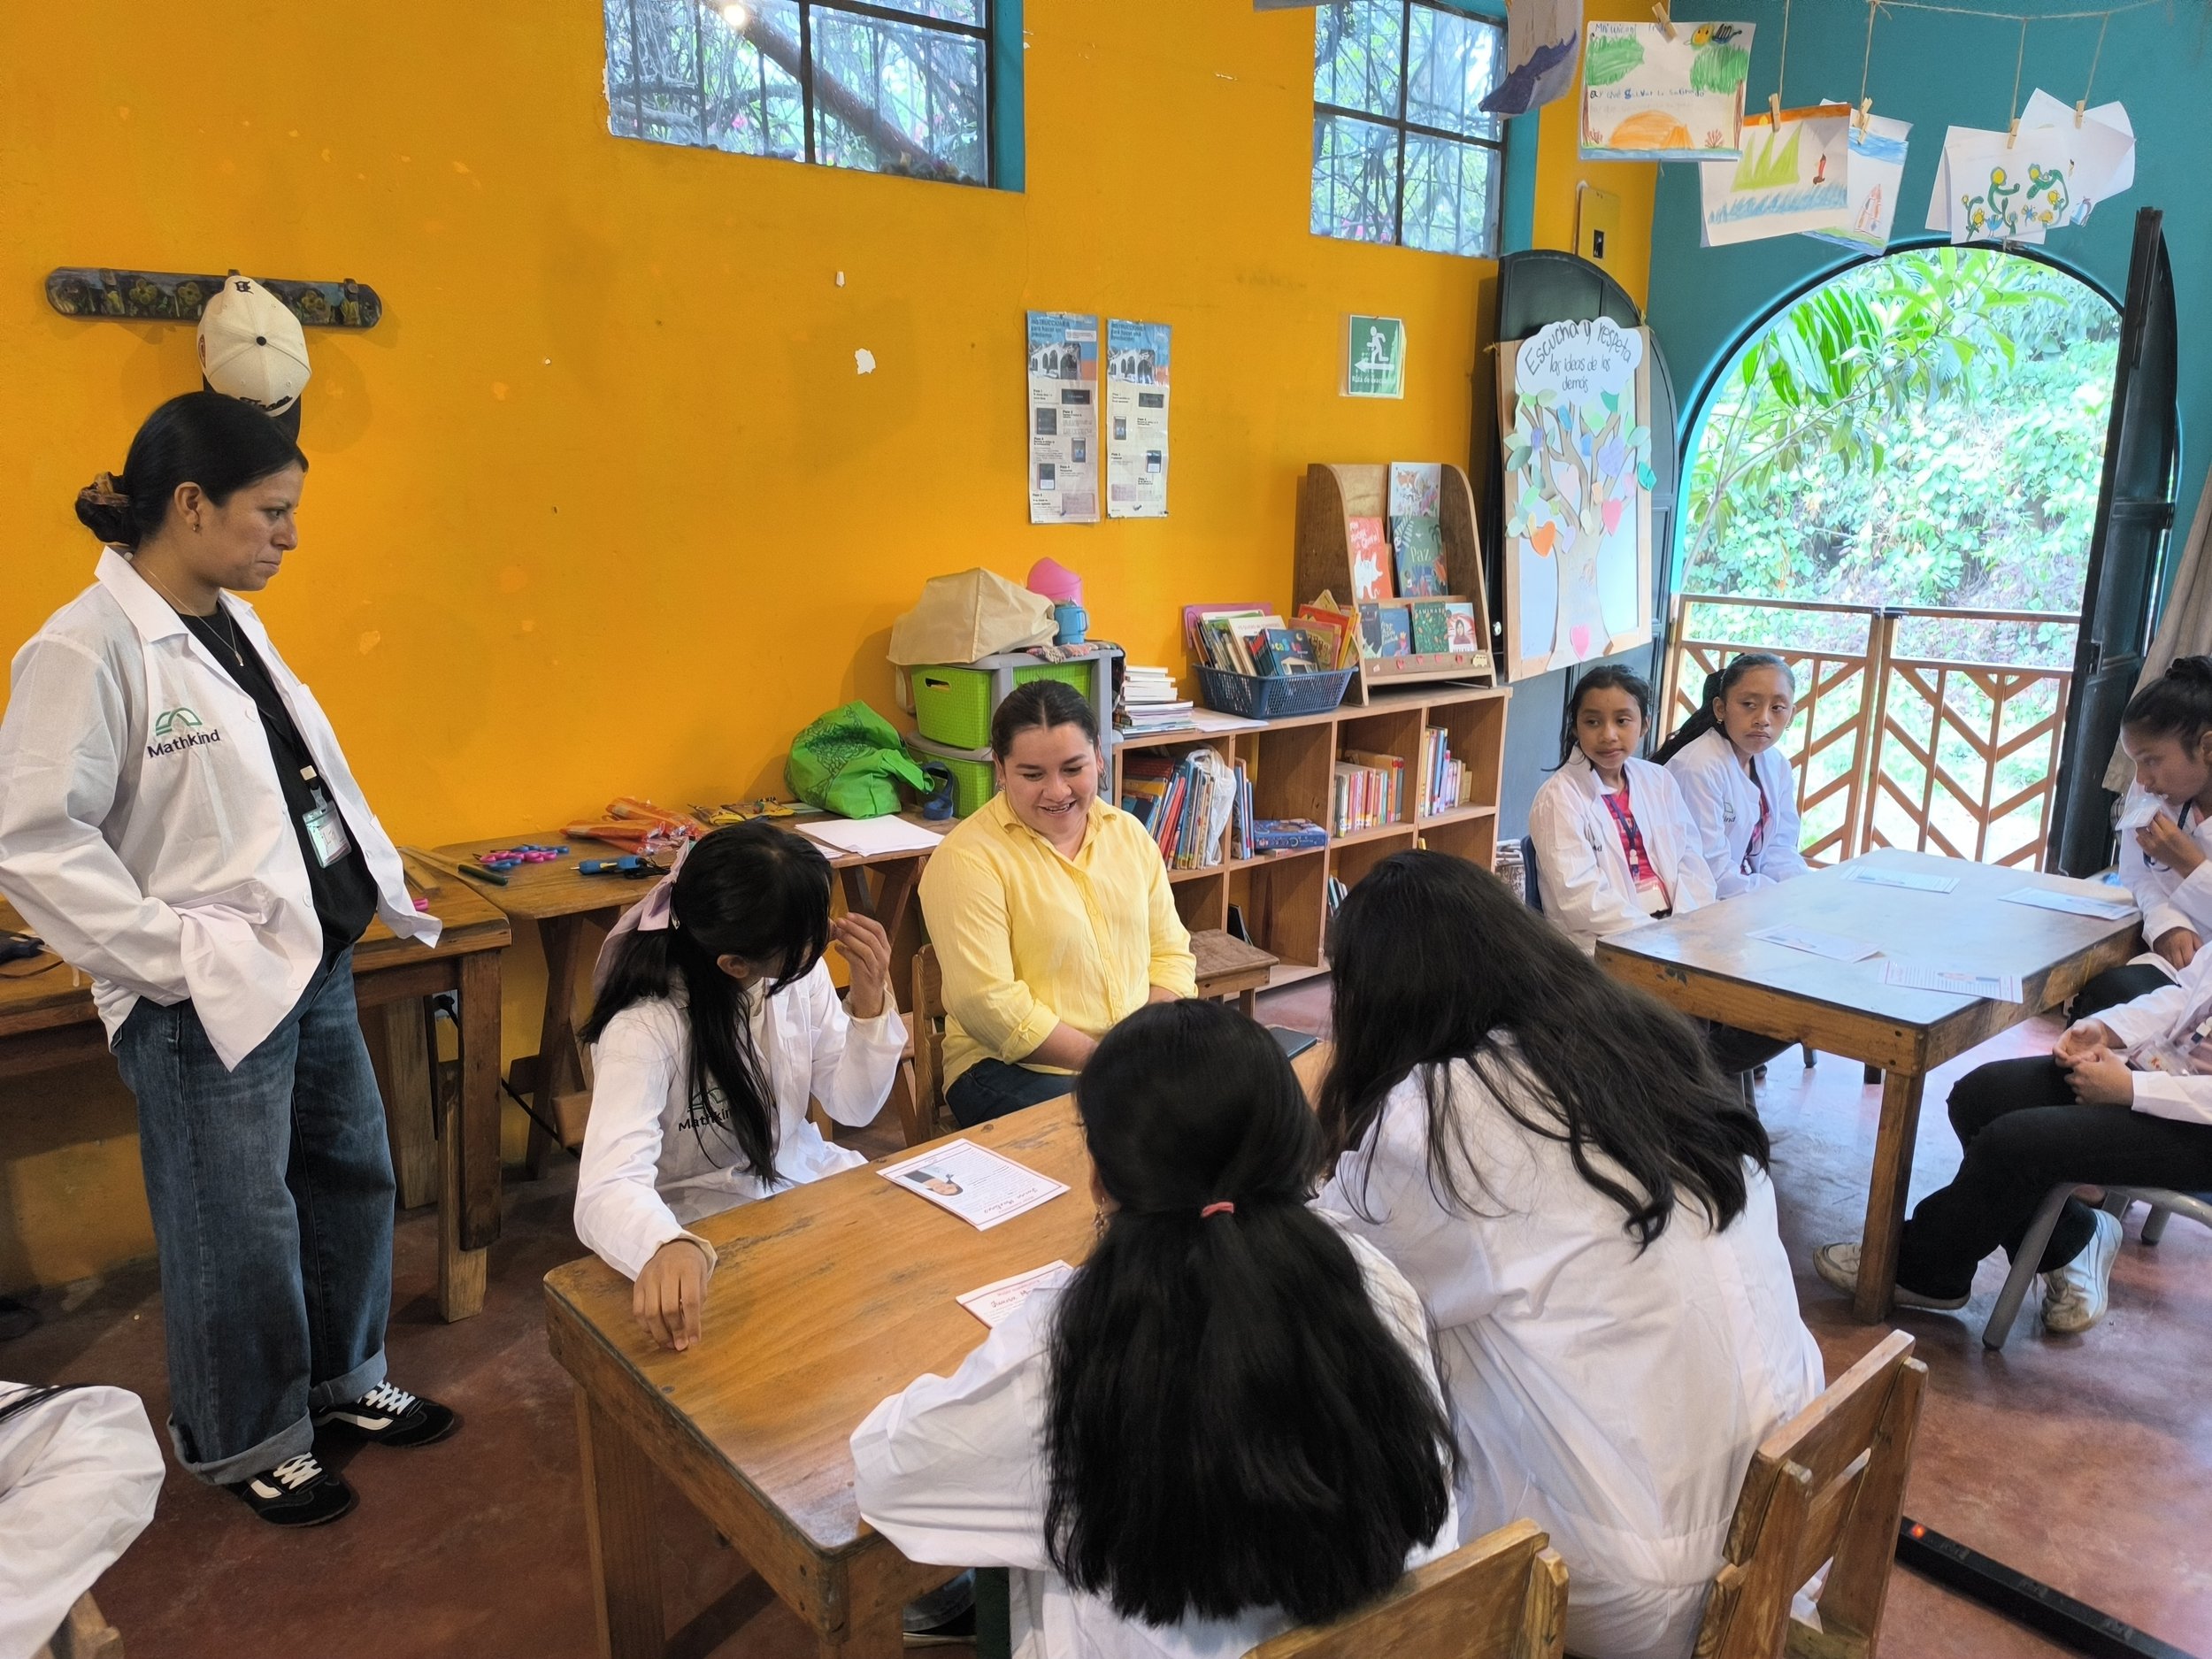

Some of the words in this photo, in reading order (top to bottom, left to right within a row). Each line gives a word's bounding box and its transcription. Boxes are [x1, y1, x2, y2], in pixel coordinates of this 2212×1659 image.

[1525, 322, 1578, 376] Escucha
[1583, 321, 1591, 345] y
[1597, 322, 1632, 364] respeta
[1564, 355, 1586, 372] ideas
[1587, 355, 1598, 372] de
[1601, 354, 1610, 372] los
[1562, 376, 1588, 394] demás
[1409, 546, 1431, 563] Paz
[147, 729, 220, 758] Mathkind
